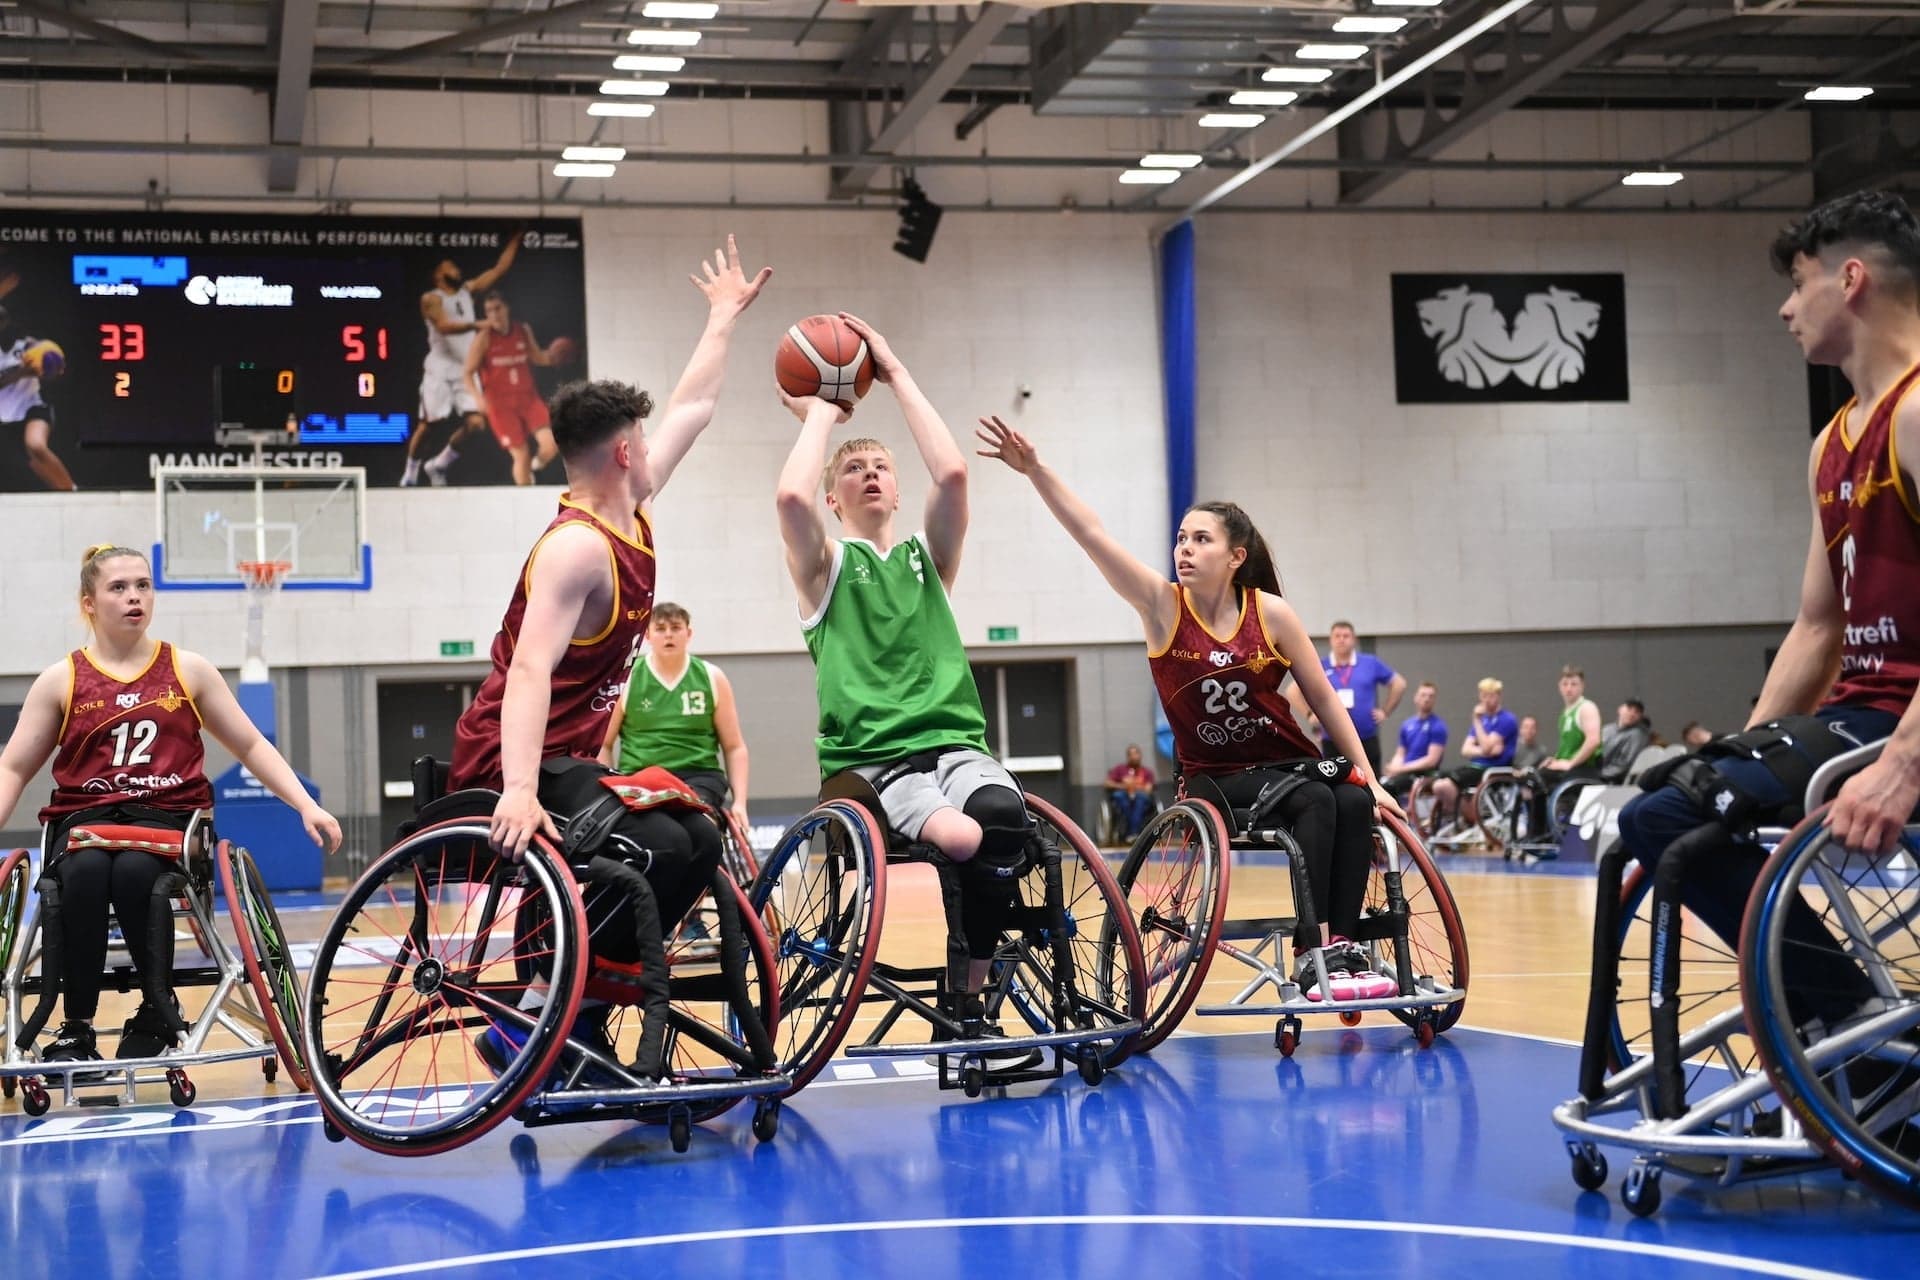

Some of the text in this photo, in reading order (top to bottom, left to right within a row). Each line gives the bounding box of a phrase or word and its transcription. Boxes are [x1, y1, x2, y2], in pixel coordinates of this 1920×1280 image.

[57, 228, 78, 243] TO
[84, 228, 116, 244] THE
[123, 229, 204, 244] NATIONAL
[209, 230, 311, 246] BASKETBALL
[317, 231, 434, 247] PERFORMANCE
[439, 232, 500, 248] CENTRE
[100, 323, 146, 361] 33
[341, 325, 389, 362] 51
[114, 372, 131, 398] 2
[277, 370, 294, 394] 0
[357, 372, 376, 398] 0
[1842, 616, 1899, 646] trefi
[1171, 649, 1201, 660] EXILE
[74, 700, 104, 714] EXILE
[680, 690, 706, 716] 13
[110, 719, 158, 767] 12
